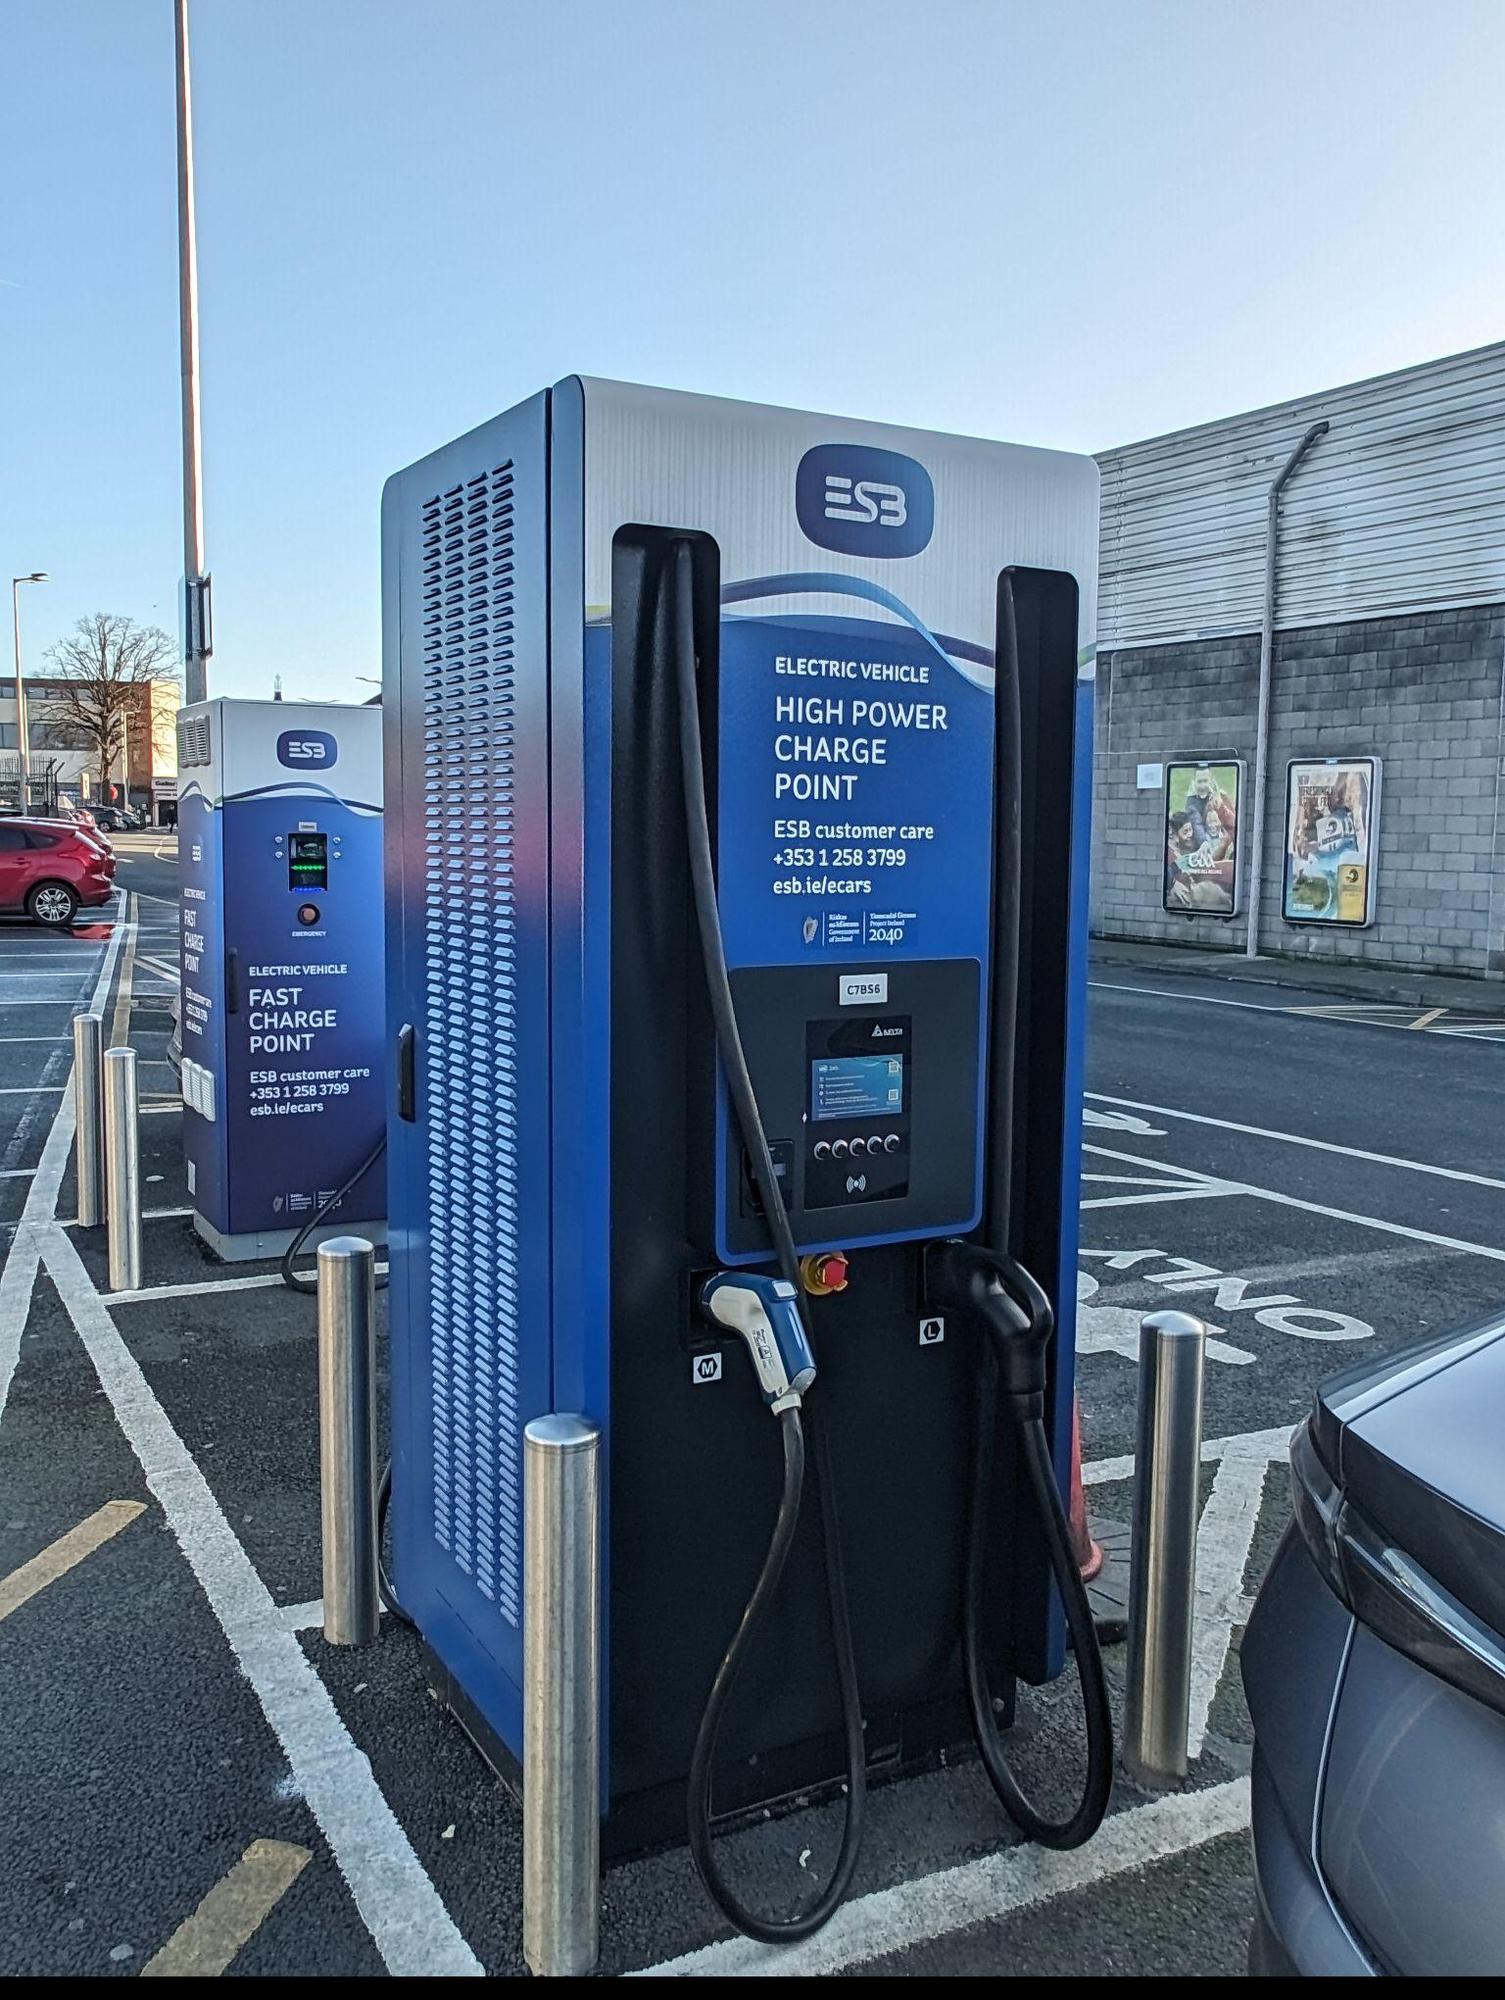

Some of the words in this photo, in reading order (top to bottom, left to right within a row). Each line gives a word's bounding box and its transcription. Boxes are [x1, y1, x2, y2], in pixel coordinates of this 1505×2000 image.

[825, 475, 907, 527] ESB
[776, 657, 856, 678] ELECTRIC
[861, 663, 929, 683] VEHICLE
[777, 697, 843, 724] HIGH
[853, 701, 947, 729] POWER
[288, 742, 326, 759] ESB
[775, 735, 886, 764] CHARGE
[776, 774, 857, 800] POINT
[775, 820, 810, 838] ESB
[816, 823, 896, 838] customer
[900, 827, 933, 839] care
[774, 849, 814, 866] +353
[819, 849, 828, 866] 1
[833, 849, 862, 866] 258
[867, 849, 905, 866] 3799
[774, 876, 871, 894] esb.ie/ecars
[869, 928, 903, 945] 2040
[249, 965, 301, 976] ELECTRIC
[302, 964, 347, 975] VEHICLE
[249, 988, 302, 1007] FAST
[249, 1010, 337, 1030] CHARGE
[250, 1034, 315, 1053] POINT
[250, 1071, 277, 1083] ESB
[280, 1070, 341, 1082] customer
[344, 1068, 369, 1078] care
[250, 1086, 280, 1099] +353
[283, 1086, 291, 1098] 1
[293, 1085, 317, 1097] 258
[319, 1083, 349, 1096] 3799
